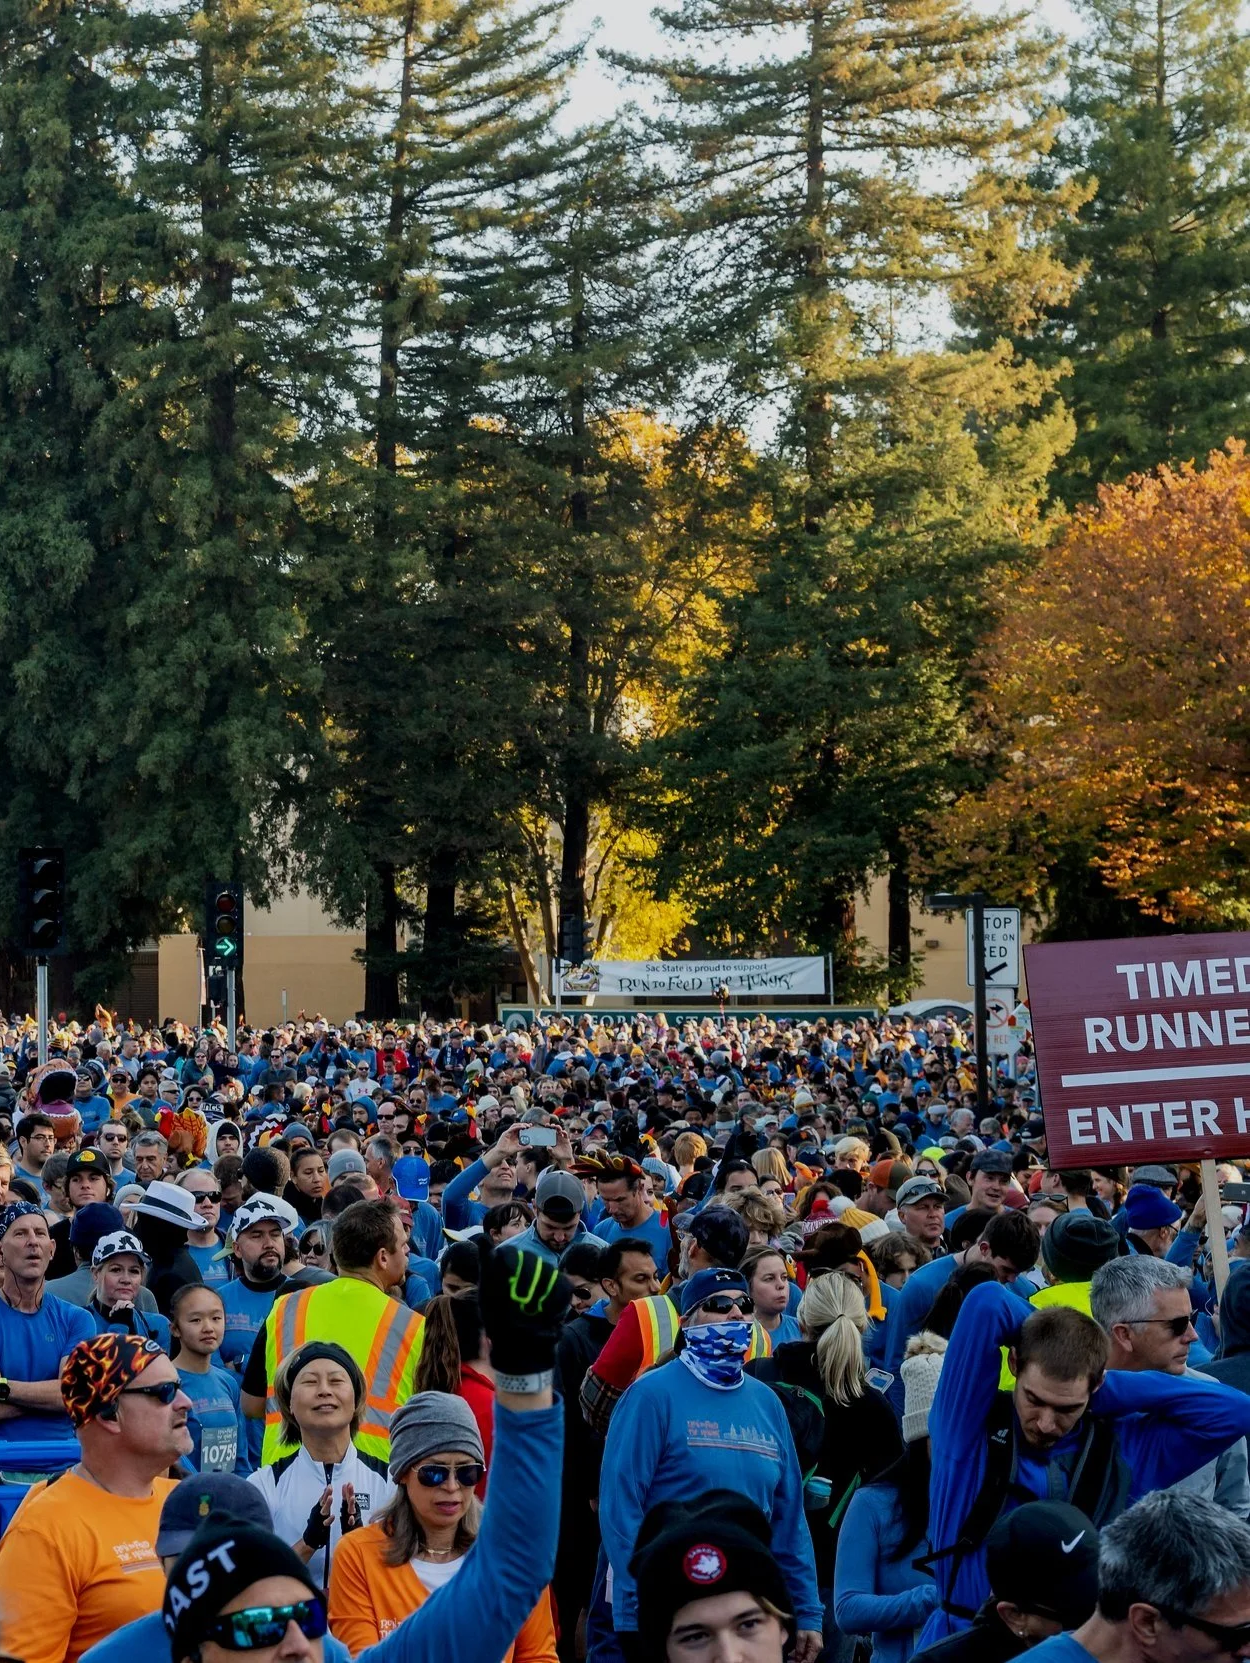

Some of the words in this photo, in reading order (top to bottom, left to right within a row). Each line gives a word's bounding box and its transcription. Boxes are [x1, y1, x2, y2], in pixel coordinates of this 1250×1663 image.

[983, 917, 1012, 929] TOP
[646, 964, 661, 972] Sac
[662, 964, 684, 972] State
[686, 964, 693, 972] is
[694, 963, 720, 974] proud
[721, 963, 732, 971] to
[733, 963, 768, 974] support
[1068, 1100, 1223, 1145] ENTER
[202, 1442, 237, 1463] 10758
